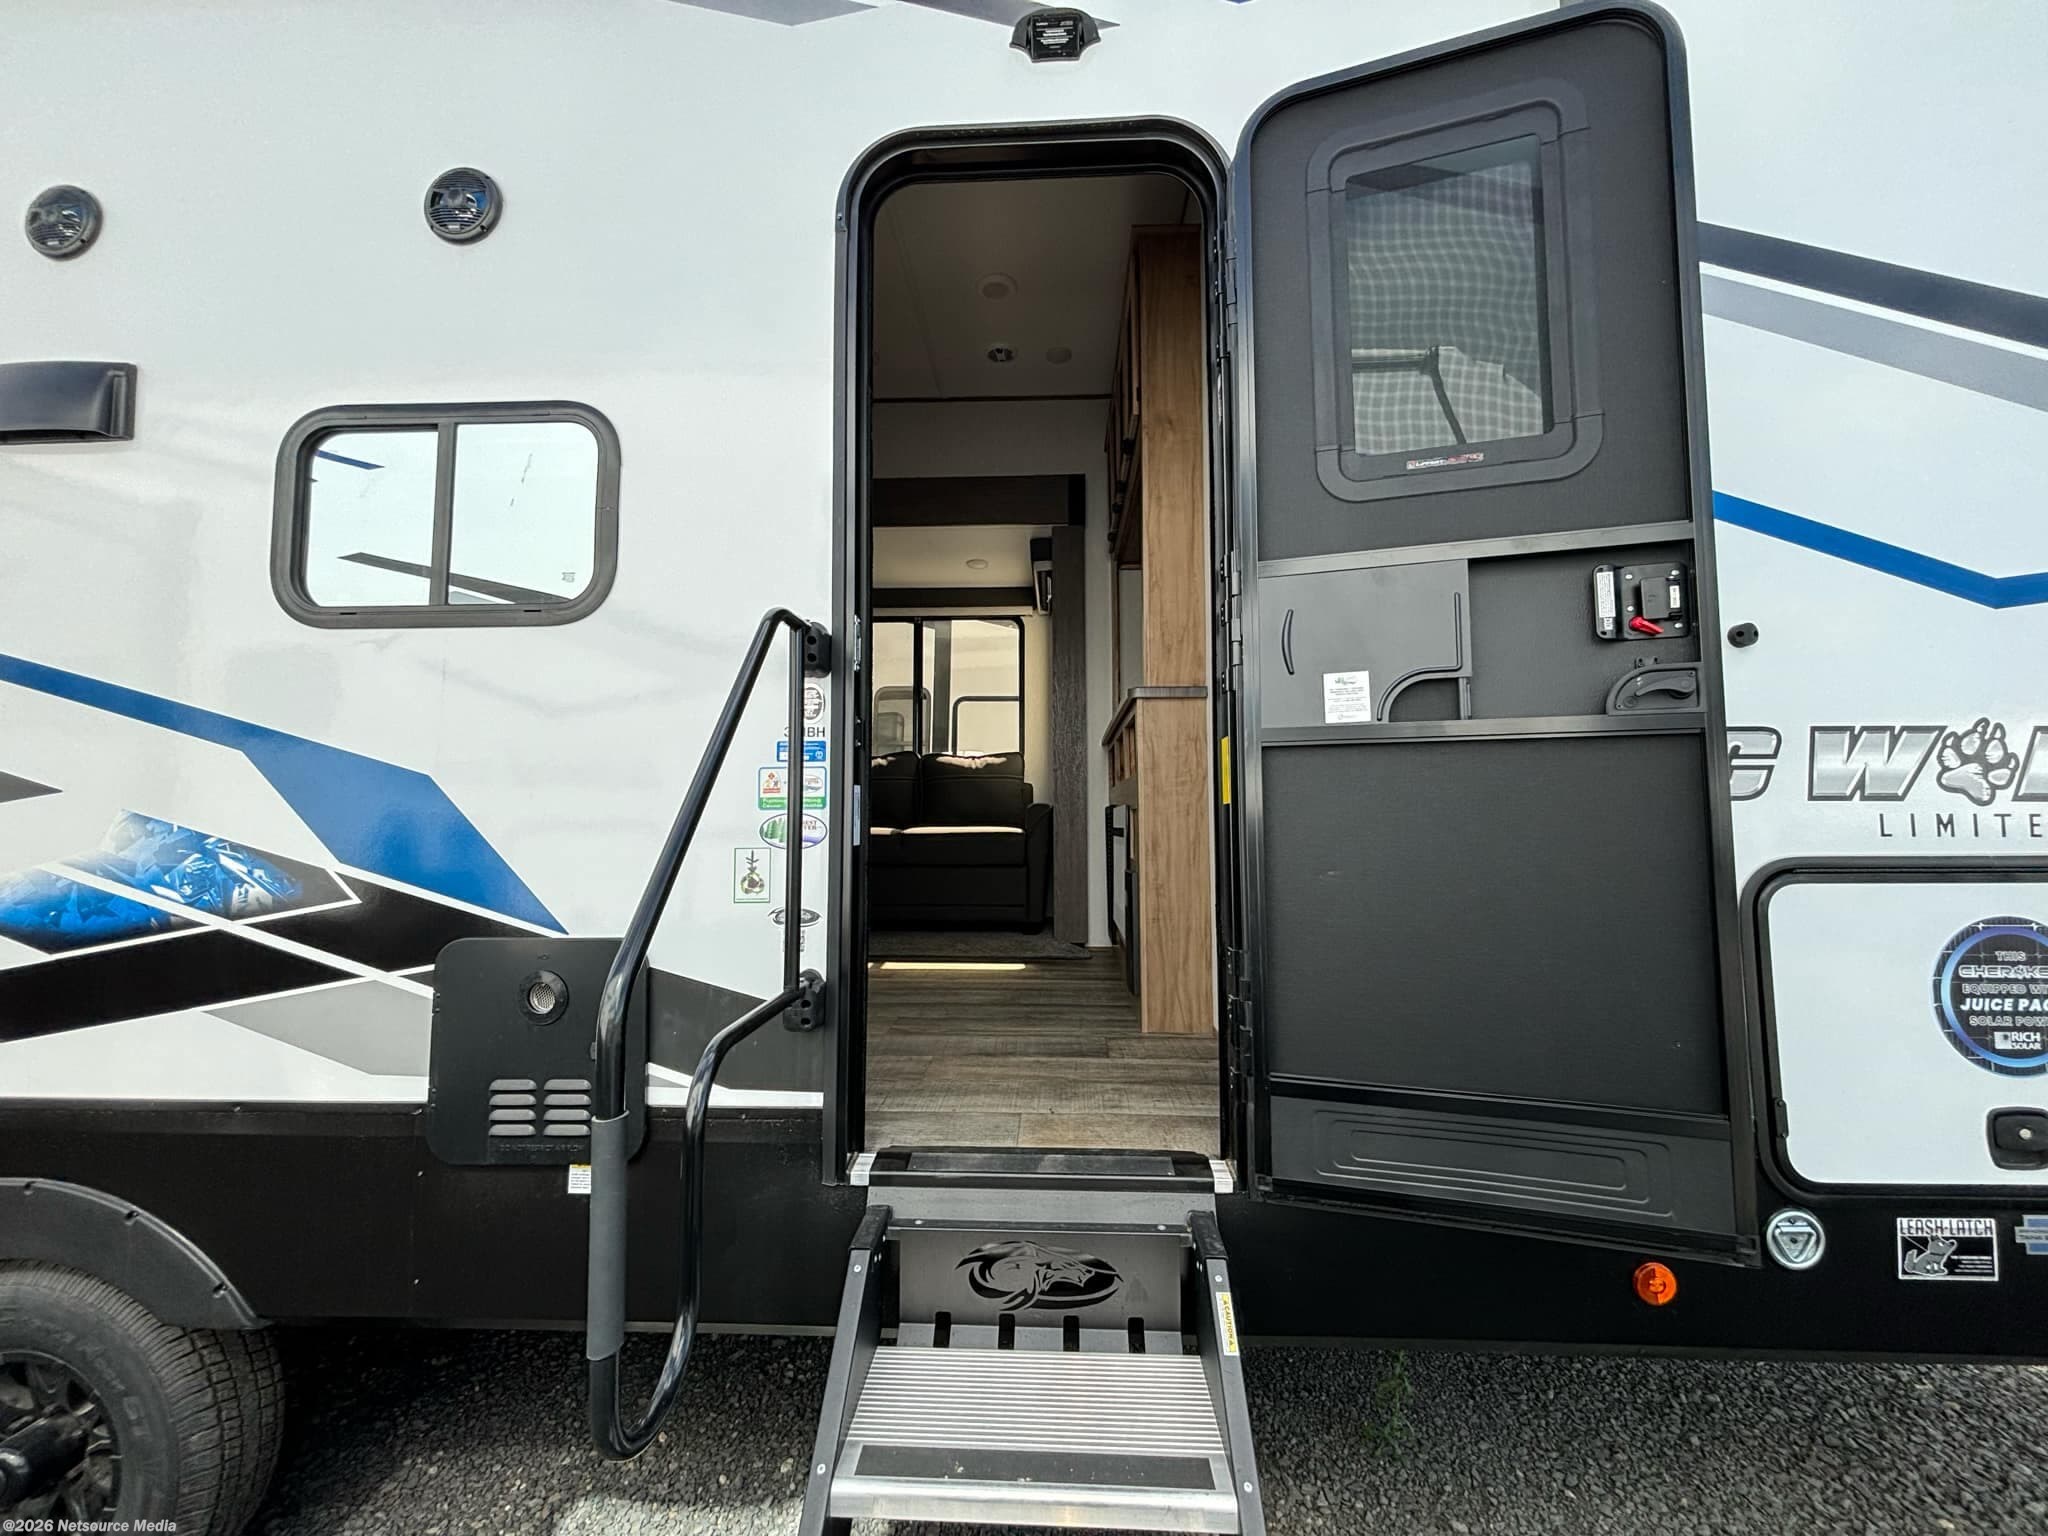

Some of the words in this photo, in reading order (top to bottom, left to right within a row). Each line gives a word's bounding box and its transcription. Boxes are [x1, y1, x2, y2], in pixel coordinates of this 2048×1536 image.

[1995, 951, 2026, 961] THIS
[1960, 998, 2013, 1011] JUICE
[1969, 1016, 2013, 1026] SOLAR
[2011, 1031, 2041, 1042] RICH
[2012, 1042, 2041, 1050] SOLAR
[1224, 1306, 1233, 1339] CAUTION
